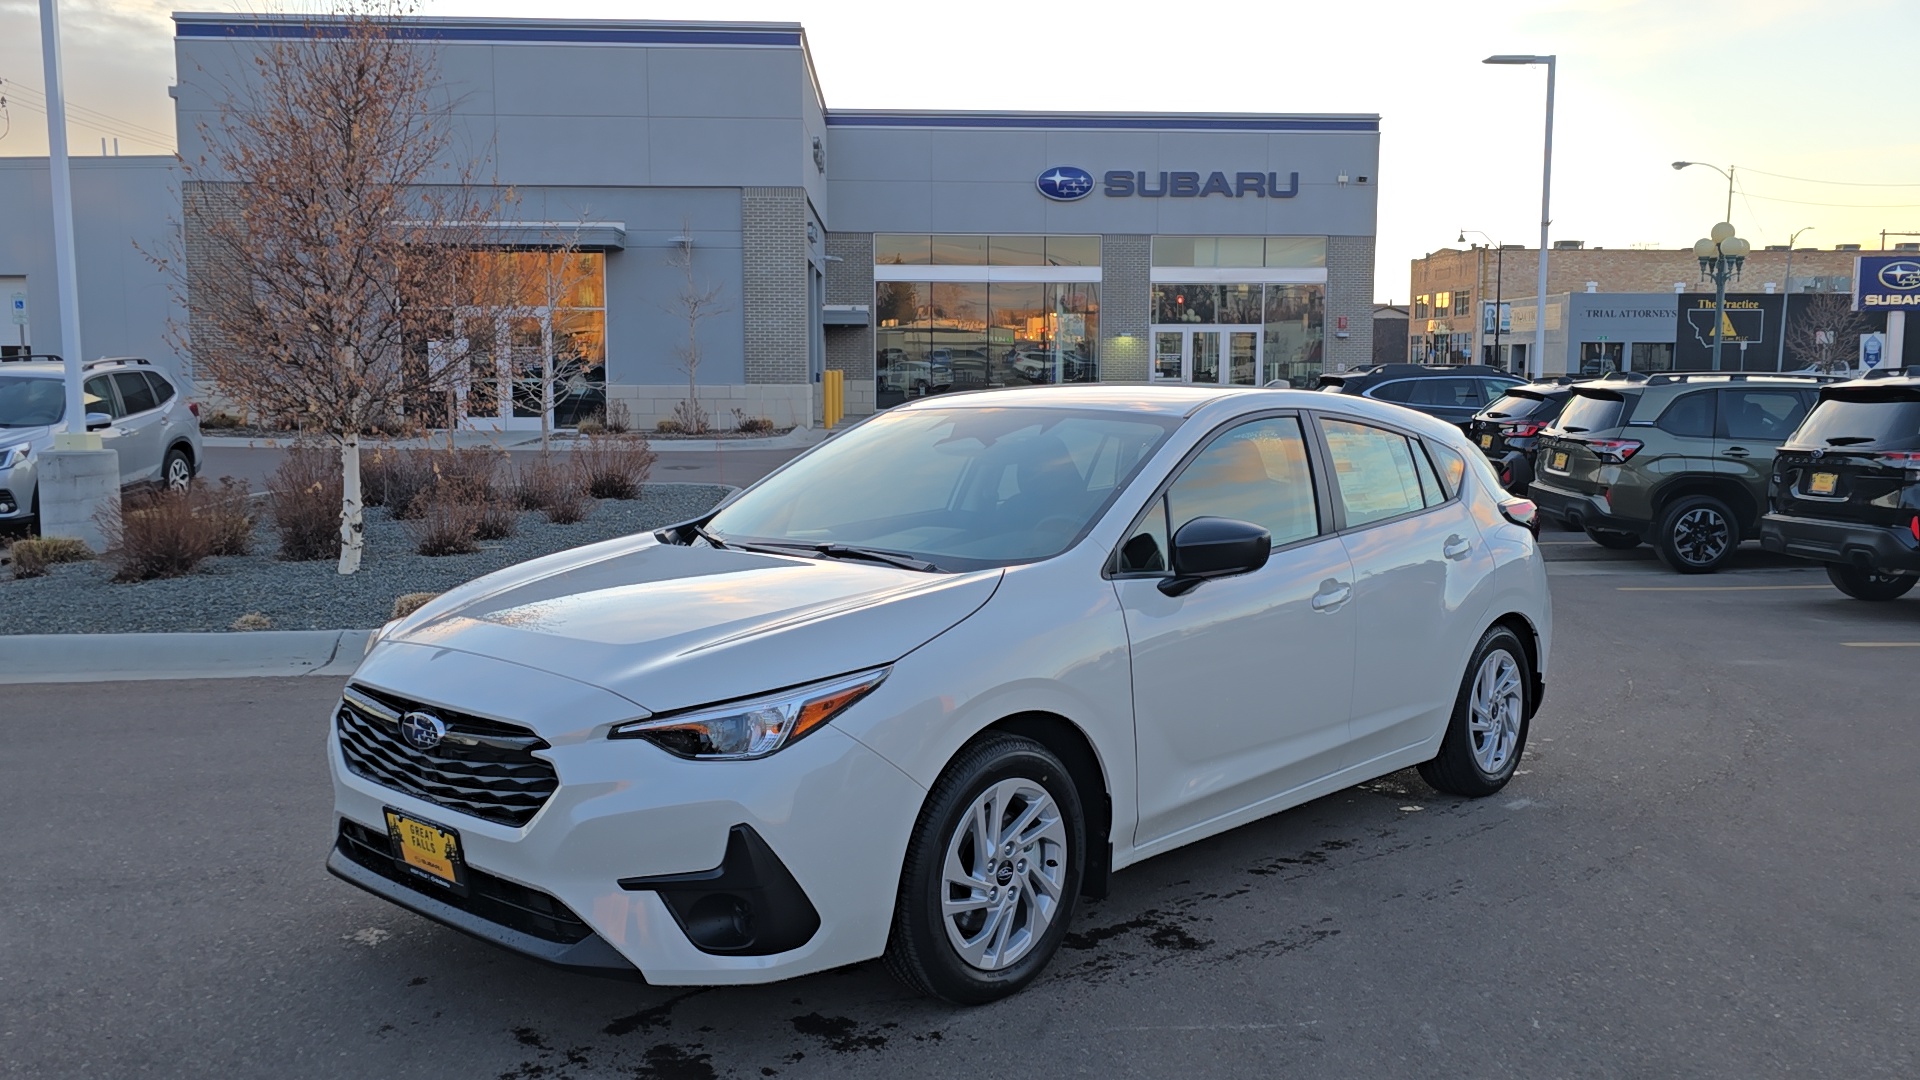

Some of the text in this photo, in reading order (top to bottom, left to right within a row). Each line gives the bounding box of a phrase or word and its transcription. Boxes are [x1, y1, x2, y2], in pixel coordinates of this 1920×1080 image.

[1104, 170, 1299, 198] SUBARU
[1698, 299, 1717, 309] The
[1864, 294, 1920, 305] SUBAR
[1586, 309, 1677, 318] TRIAL ATTORNEYS
[409, 824, 434, 841] GREAT
[411, 836, 436, 854] FALLS
